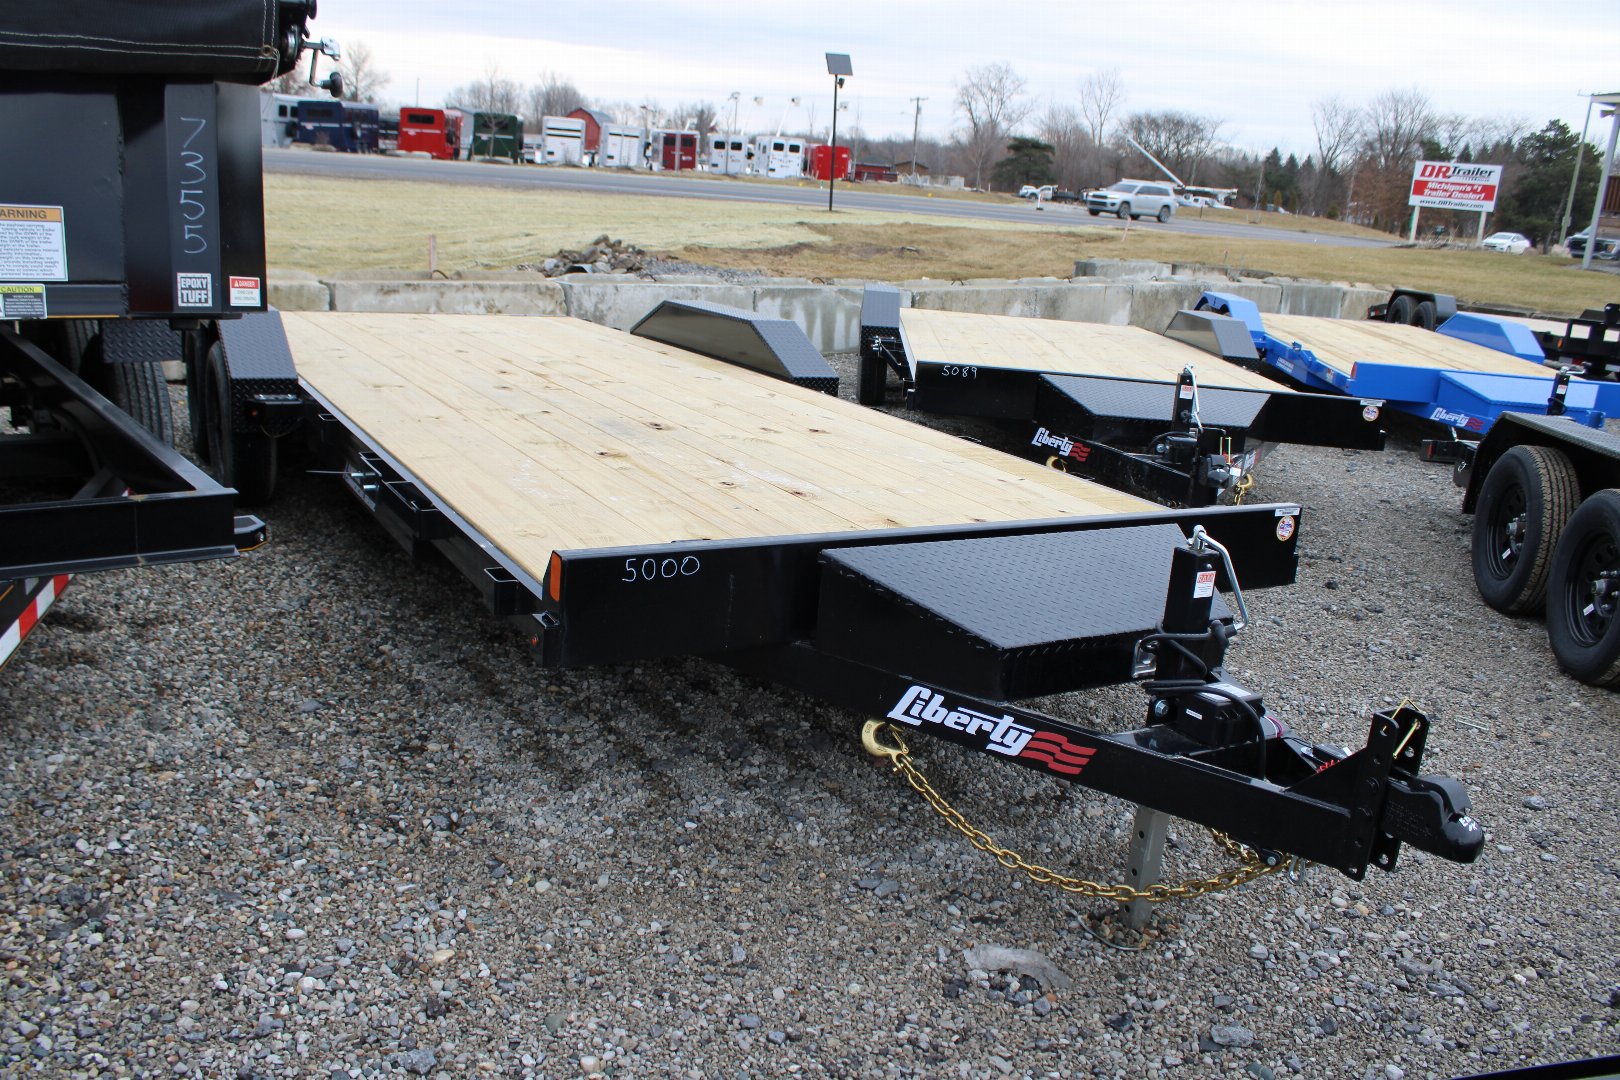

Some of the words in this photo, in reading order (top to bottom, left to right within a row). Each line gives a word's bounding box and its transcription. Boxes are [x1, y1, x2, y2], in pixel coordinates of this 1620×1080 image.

[1420, 164, 1450, 179] DR
[1451, 166, 1495, 178] Trailer
[180, 117, 207, 254] 7355
[1424, 189, 1451, 198] Trailer
[0, 209, 47, 219] ARNING
[181, 278, 207, 288] EPOXY
[181, 290, 207, 302] TUFF
[941, 365, 978, 379] 5089
[1430, 408, 1470, 427] Liberty
[1032, 427, 1074, 456] Liberty
[622, 556, 700, 582] 5000
[887, 685, 1035, 757] Liberty
